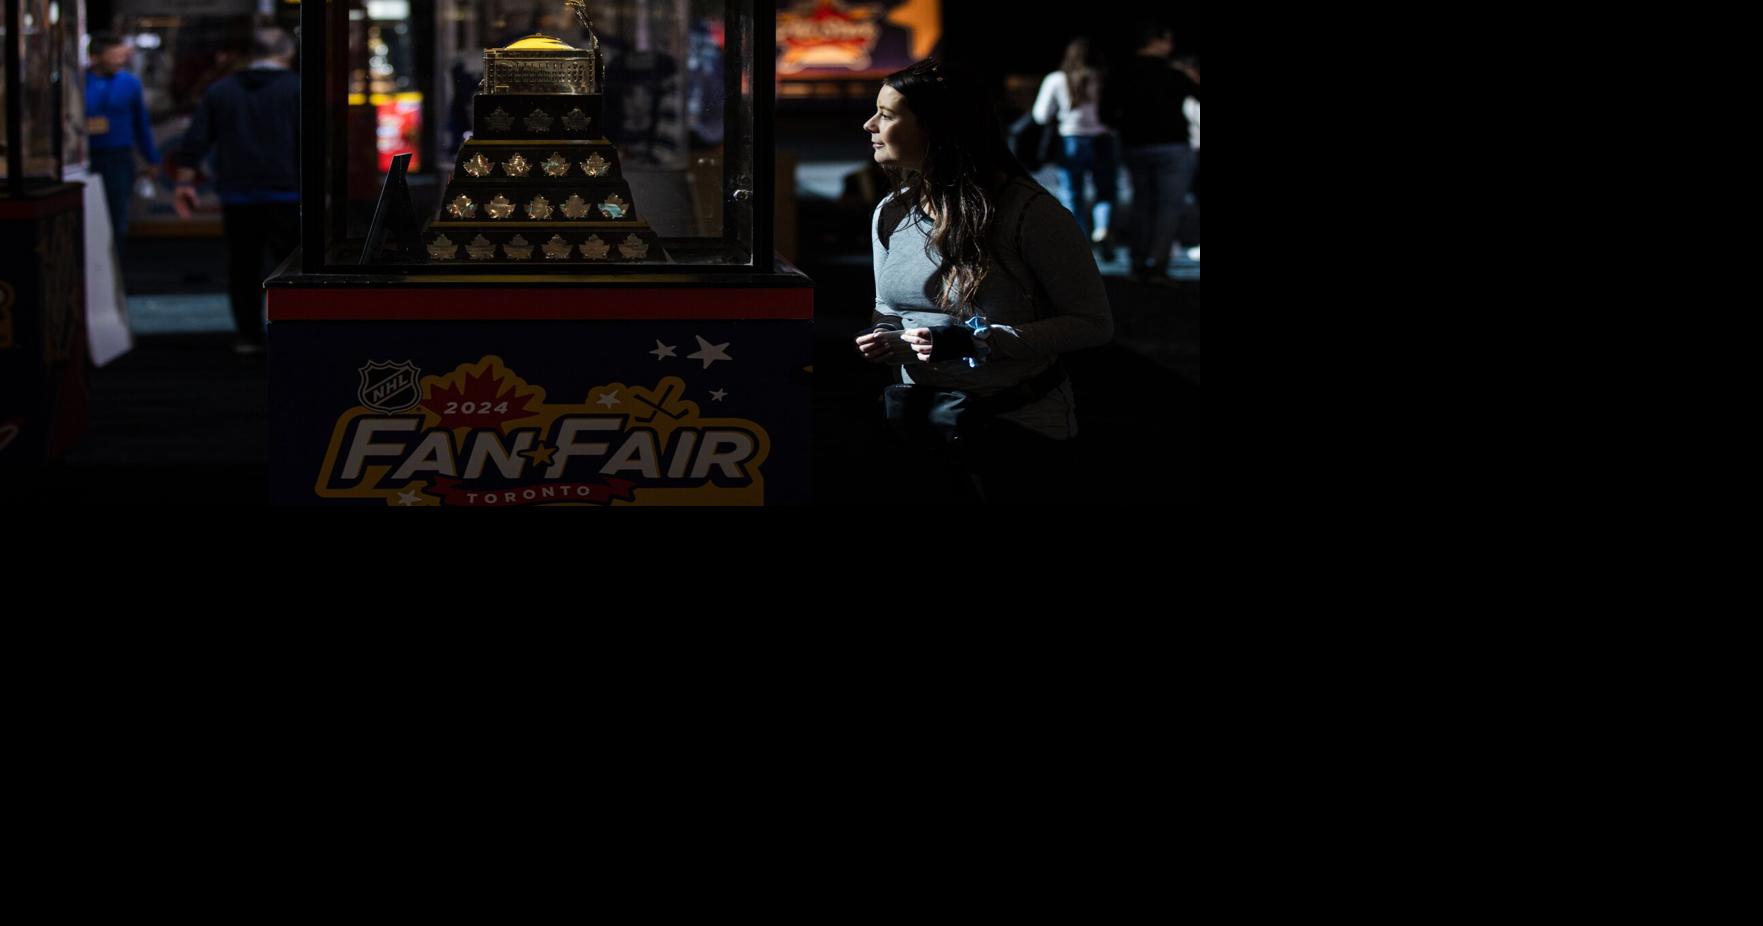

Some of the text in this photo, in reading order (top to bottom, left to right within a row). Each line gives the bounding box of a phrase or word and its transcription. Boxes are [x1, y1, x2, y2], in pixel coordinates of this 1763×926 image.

[371, 372, 411, 403] NHL
[443, 401, 509, 415] 2024
[340, 417, 754, 480] FAN FAIR
[466, 484, 591, 504] TORONTO
